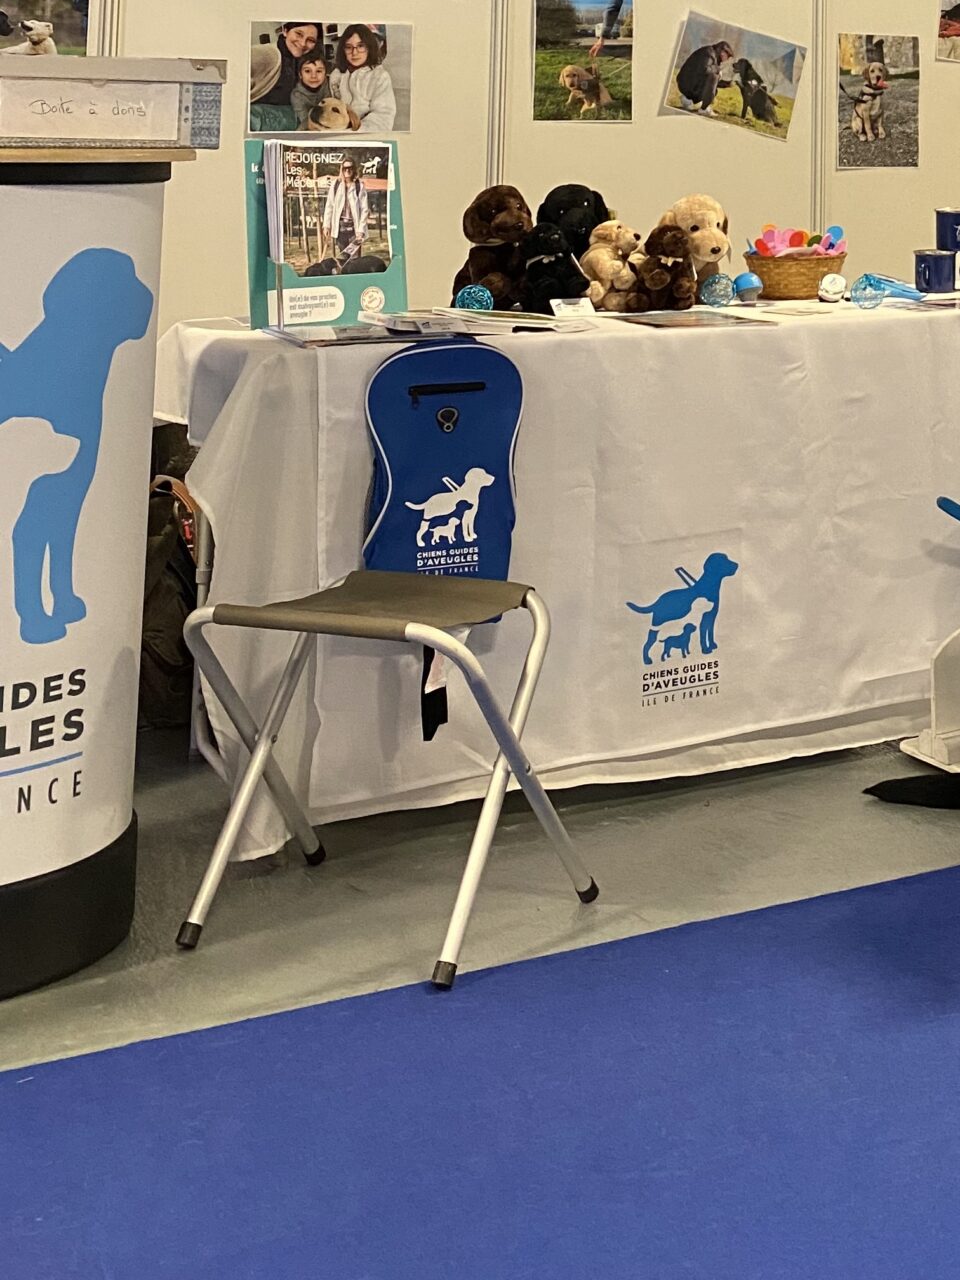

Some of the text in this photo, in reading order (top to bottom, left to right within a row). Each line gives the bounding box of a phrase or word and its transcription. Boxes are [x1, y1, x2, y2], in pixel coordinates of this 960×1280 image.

[29, 97, 146, 117] Boite à dons
[285, 152, 343, 164] REJOIGNEZ
[287, 164, 302, 175] Les
[417, 547, 479, 559] CHIENS GUIDES
[417, 554, 479, 567] D'AVEUGLES
[643, 660, 718, 681] CHIENS GUIDES
[643, 671, 719, 692] D'AVEUGLES
[642, 686, 719, 707] ILE DE FRANCE
[0, 708, 84, 758] LES
[17, 770, 82, 814] NCE
